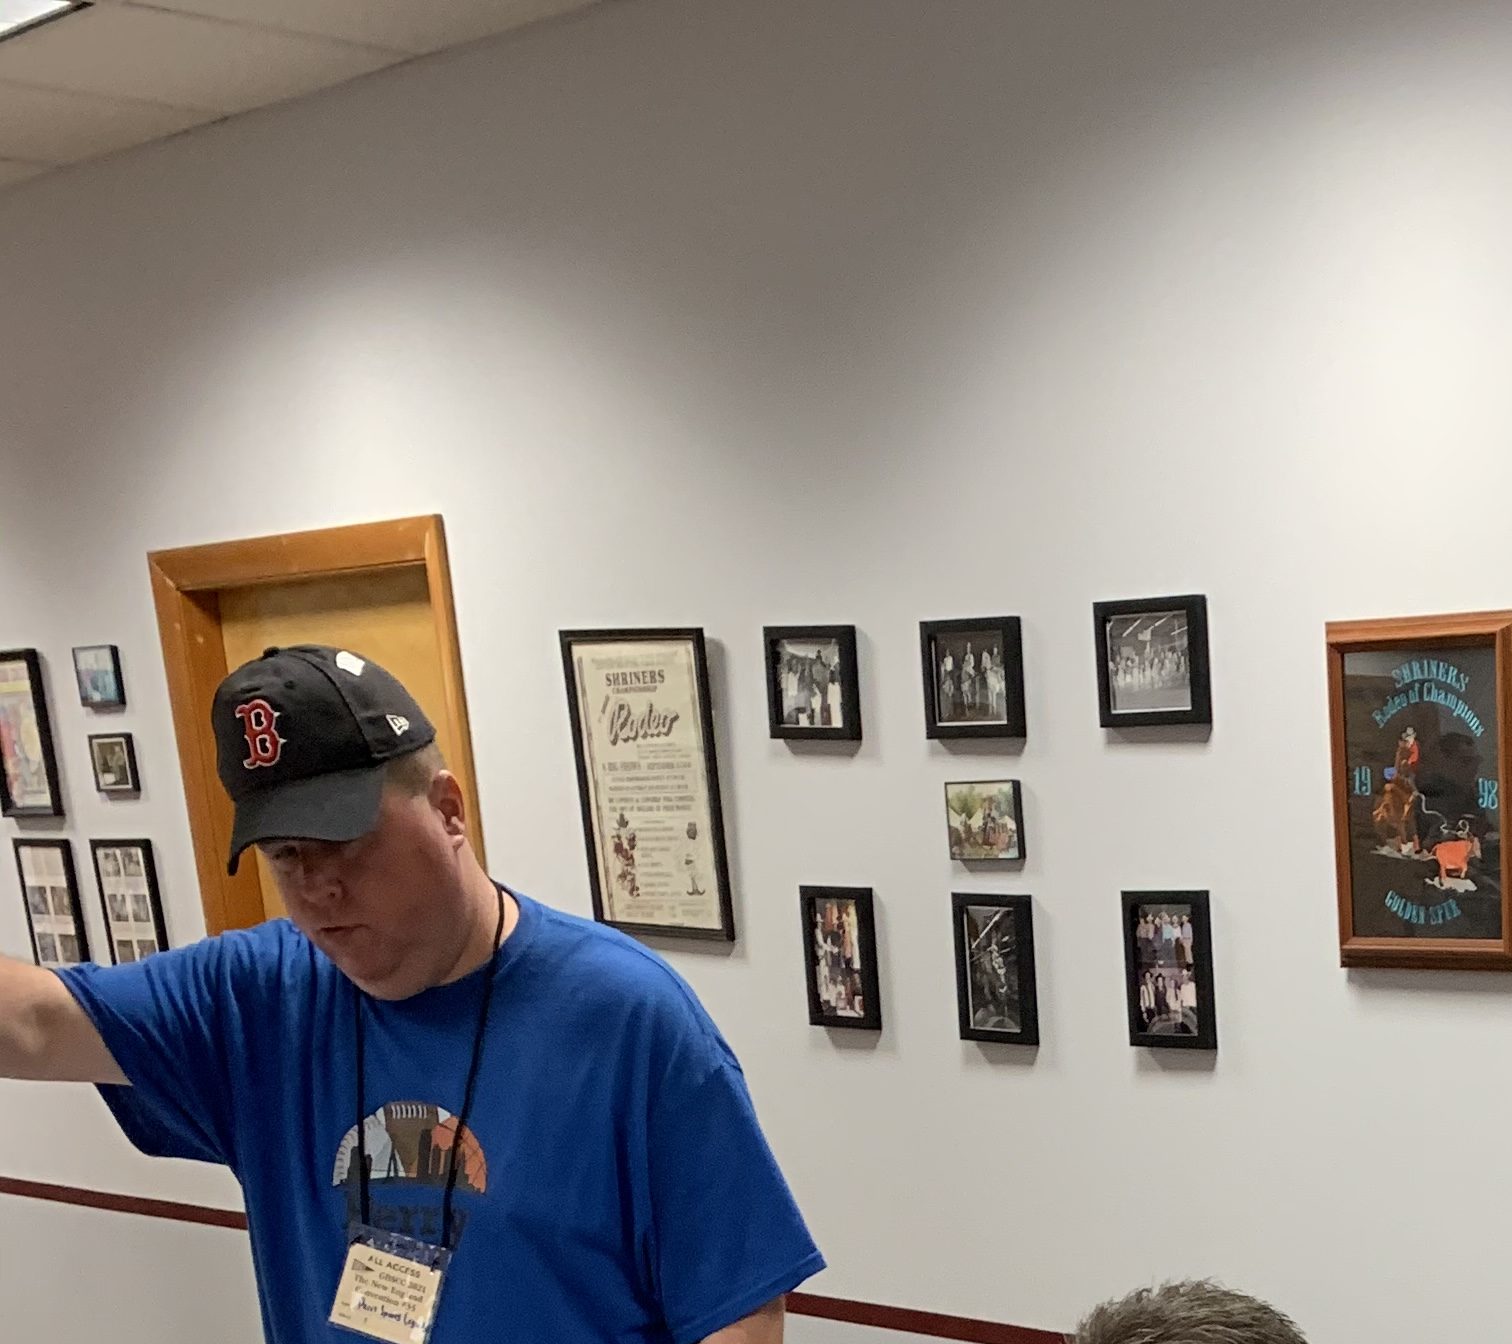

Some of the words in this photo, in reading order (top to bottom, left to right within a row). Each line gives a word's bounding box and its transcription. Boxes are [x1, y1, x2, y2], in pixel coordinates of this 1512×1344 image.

[605, 669, 665, 687] SHRINERS
[1391, 660, 1470, 693] SHRINERS
[1423, 682, 1485, 738] Champions
[1353, 767, 1372, 796] 19
[1477, 777, 1499, 810] 98
[368, 1254, 383, 1267] ALL
[386, 1261, 422, 1280] ACCESS
[354, 1274, 369, 1286] The
[371, 1279, 389, 1291] New
